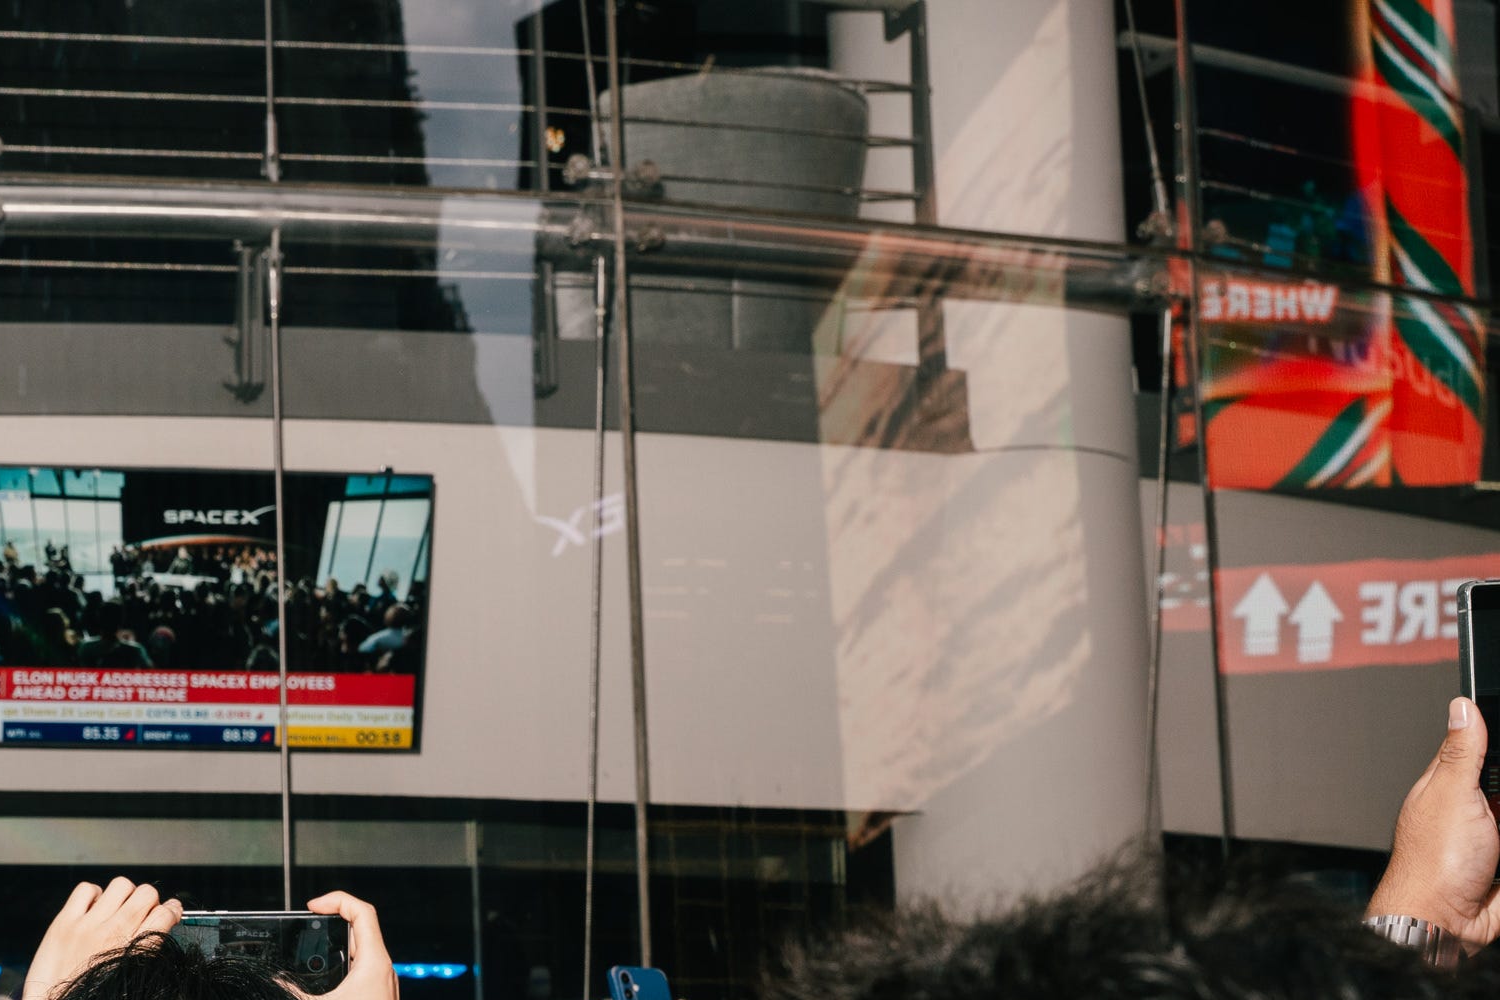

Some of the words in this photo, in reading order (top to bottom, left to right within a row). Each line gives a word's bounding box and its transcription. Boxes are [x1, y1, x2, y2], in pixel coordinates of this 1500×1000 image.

[163, 507, 270, 525] SPACEX
[12, 670, 53, 685] ELON
[56, 671, 99, 686] MUSK
[101, 672, 187, 687] ADDRESSES
[190, 674, 247, 689] SPACEX
[249, 676, 336, 691] EMPOYEES
[12, 686, 66, 699] AHEAD
[68, 687, 89, 700] OF
[92, 687, 134, 701] FIRST
[137, 687, 187, 702] TRADE
